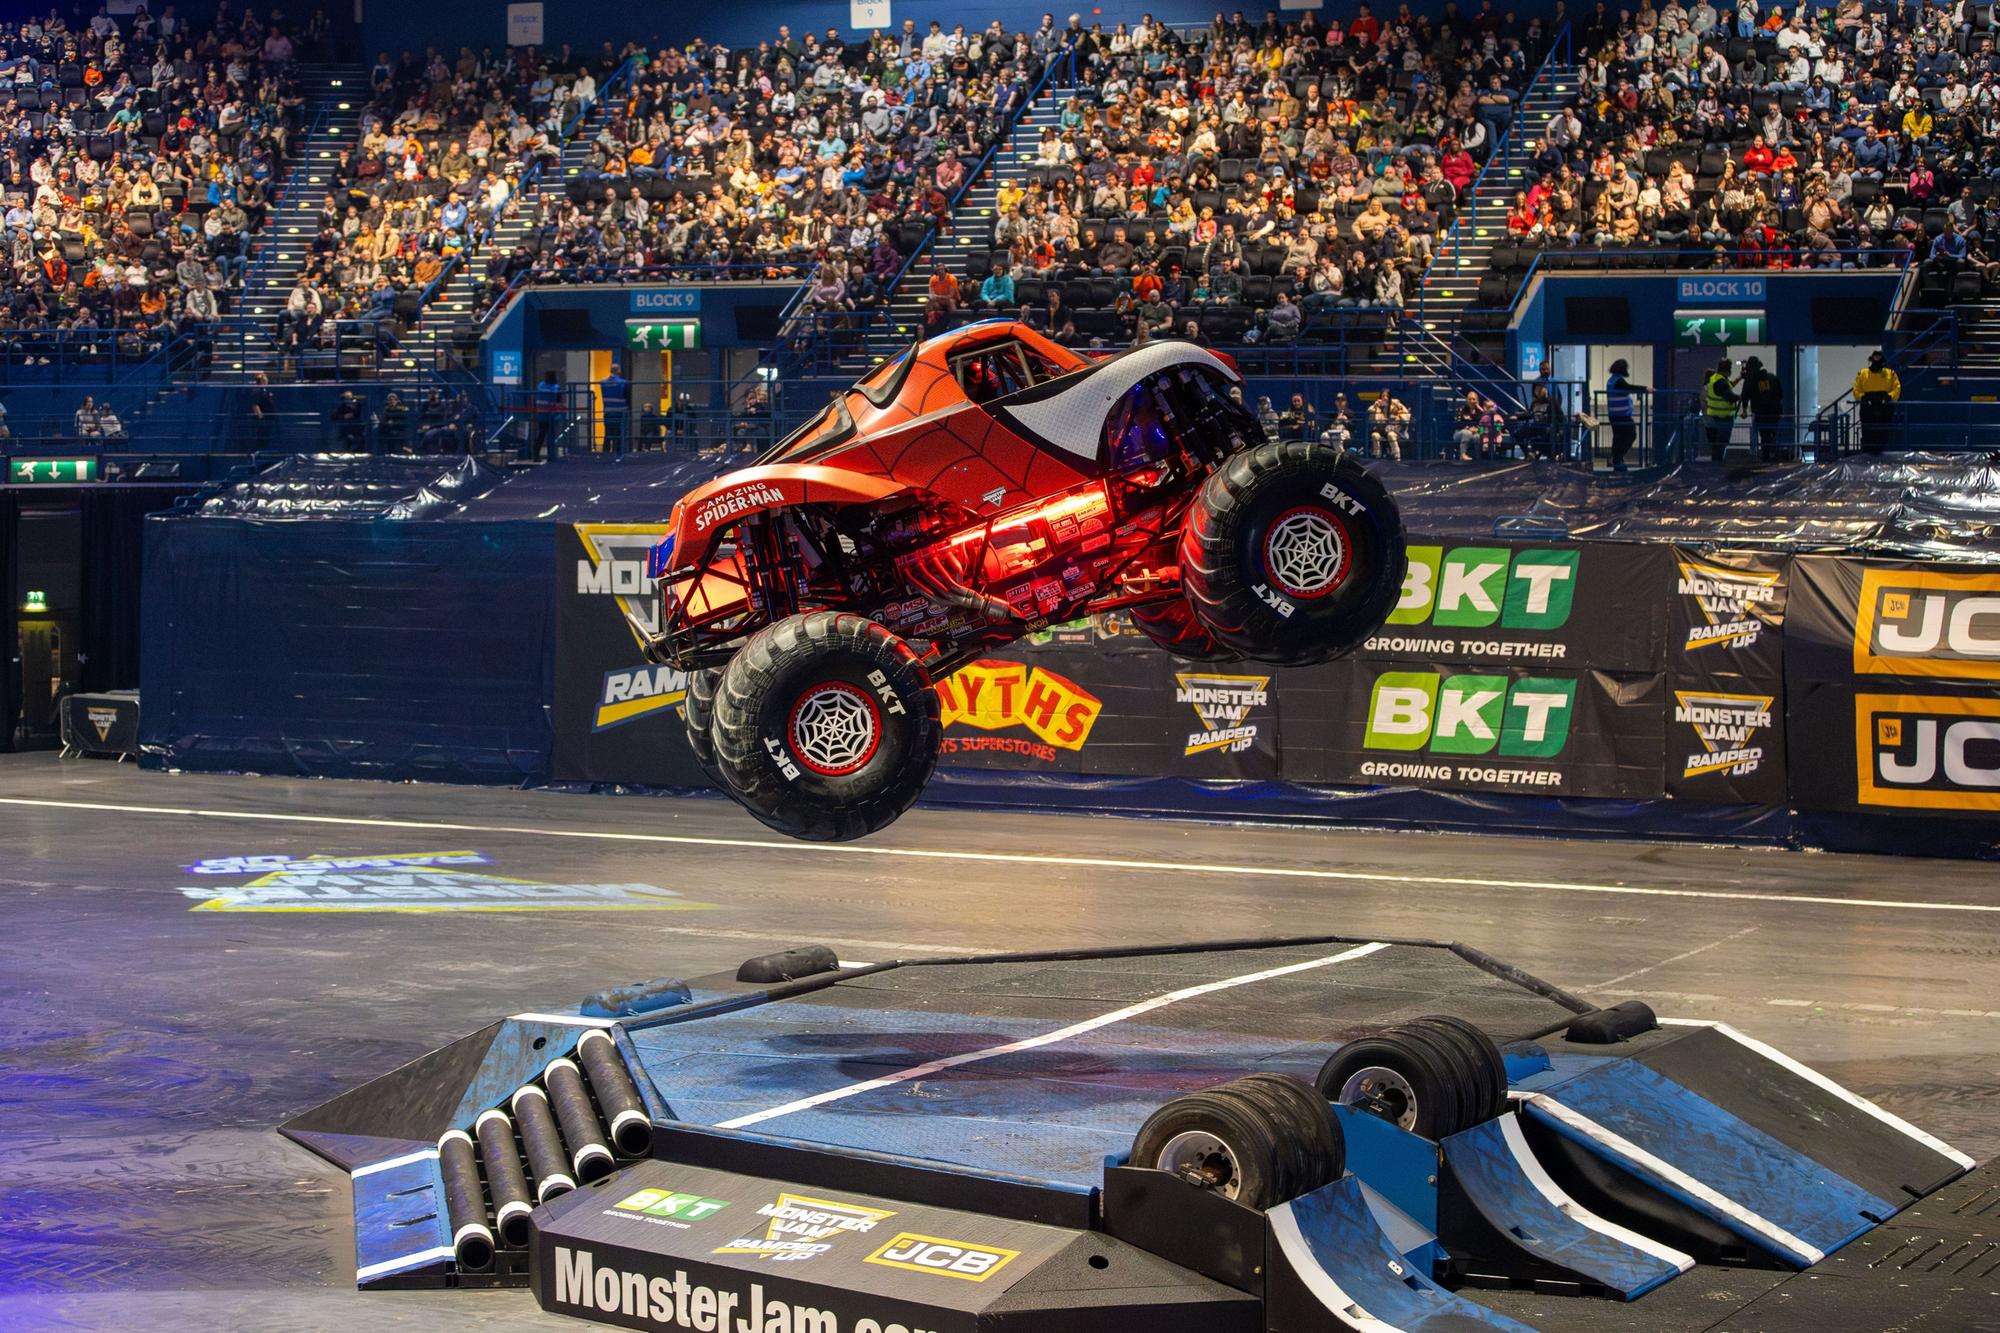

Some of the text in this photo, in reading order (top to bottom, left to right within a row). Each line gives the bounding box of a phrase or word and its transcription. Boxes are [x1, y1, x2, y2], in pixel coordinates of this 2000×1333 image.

[1682, 281, 1762, 296] BLOCK 10
[637, 293, 694, 307] BLOCK 9
[706, 482, 766, 509] AMAZING
[1319, 482, 1366, 516] BKT
[1395, 562, 1571, 614] BKT
[1678, 578, 1774, 602] MONSTER
[1251, 582, 1296, 618] BKT
[1704, 597, 1745, 614] JAM
[1688, 619, 1762, 641] RAMPED
[1732, 632, 1758, 649] UP
[1363, 636, 1566, 658] GROWING TOGETHER
[867, 669, 907, 715] BKT
[1176, 687, 1267, 706] MONSTER
[1202, 703, 1242, 720] JAM
[1372, 686, 1568, 742] BKT
[1675, 706, 1771, 728] MONSTER
[1188, 725, 1257, 746] RAMPED
[1702, 724, 1746, 742] JAM
[961, 736, 1056, 762] SUPERSTORES
[1231, 737, 1252, 752] UP
[763, 736, 801, 781] BKT
[1687, 747, 1762, 769] RAMPED
[1732, 761, 1758, 776] UP
[1360, 761, 1562, 786] GROWING TOGETHER
[176, 882, 682, 900] MONSTER
[623, 1192, 723, 1217] BKT
[602, 1209, 691, 1230] GROWING TOGETHER
[756, 1203, 879, 1233] MONSTER
[772, 1220, 831, 1239] JAM
[725, 1238, 832, 1253] RAMPED
[772, 1252, 816, 1261] UP
[883, 1241, 1000, 1274] JCB
